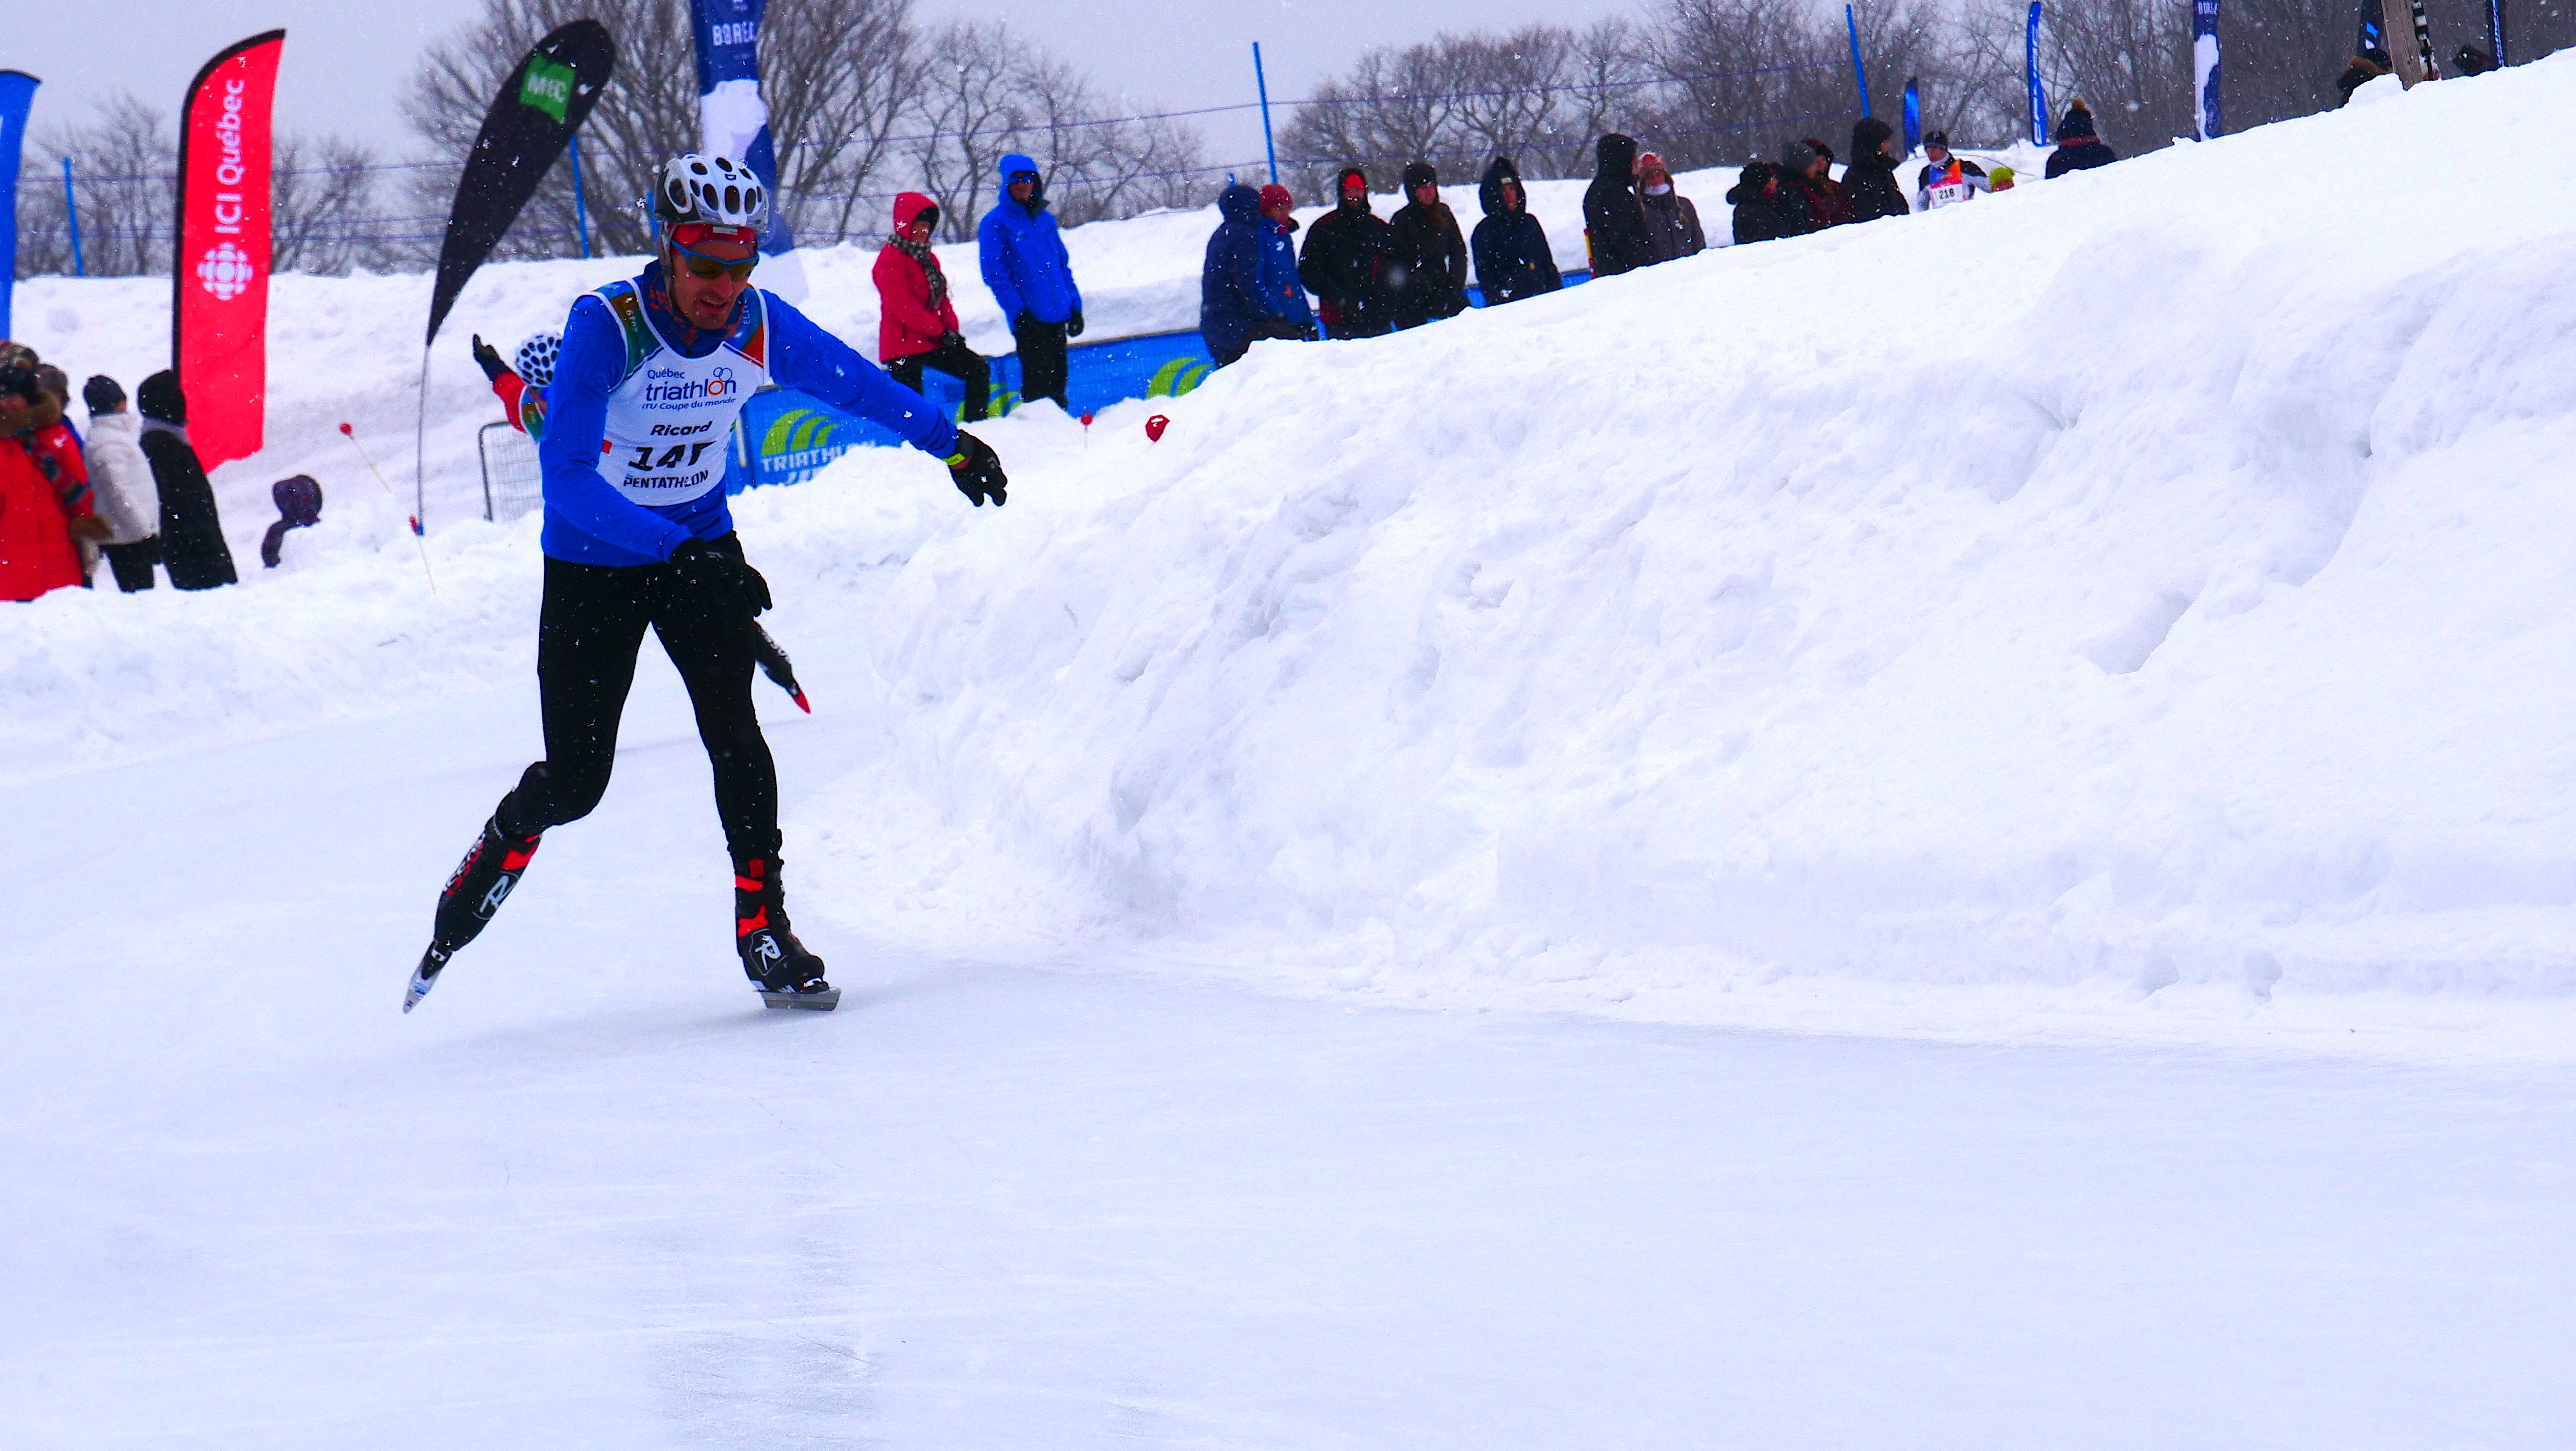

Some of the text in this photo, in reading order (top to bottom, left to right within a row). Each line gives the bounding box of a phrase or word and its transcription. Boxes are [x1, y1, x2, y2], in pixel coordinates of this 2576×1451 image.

[214, 78, 245, 234] ICI Québec
[1940, 188, 1955, 199] 218
[647, 368, 685, 379] Québec
[646, 378, 736, 401] triathlon
[659, 403, 689, 411] Coupe
[705, 397, 736, 407] monde
[650, 421, 713, 436] Ricard
[623, 470, 709, 488] PENTATHLON
